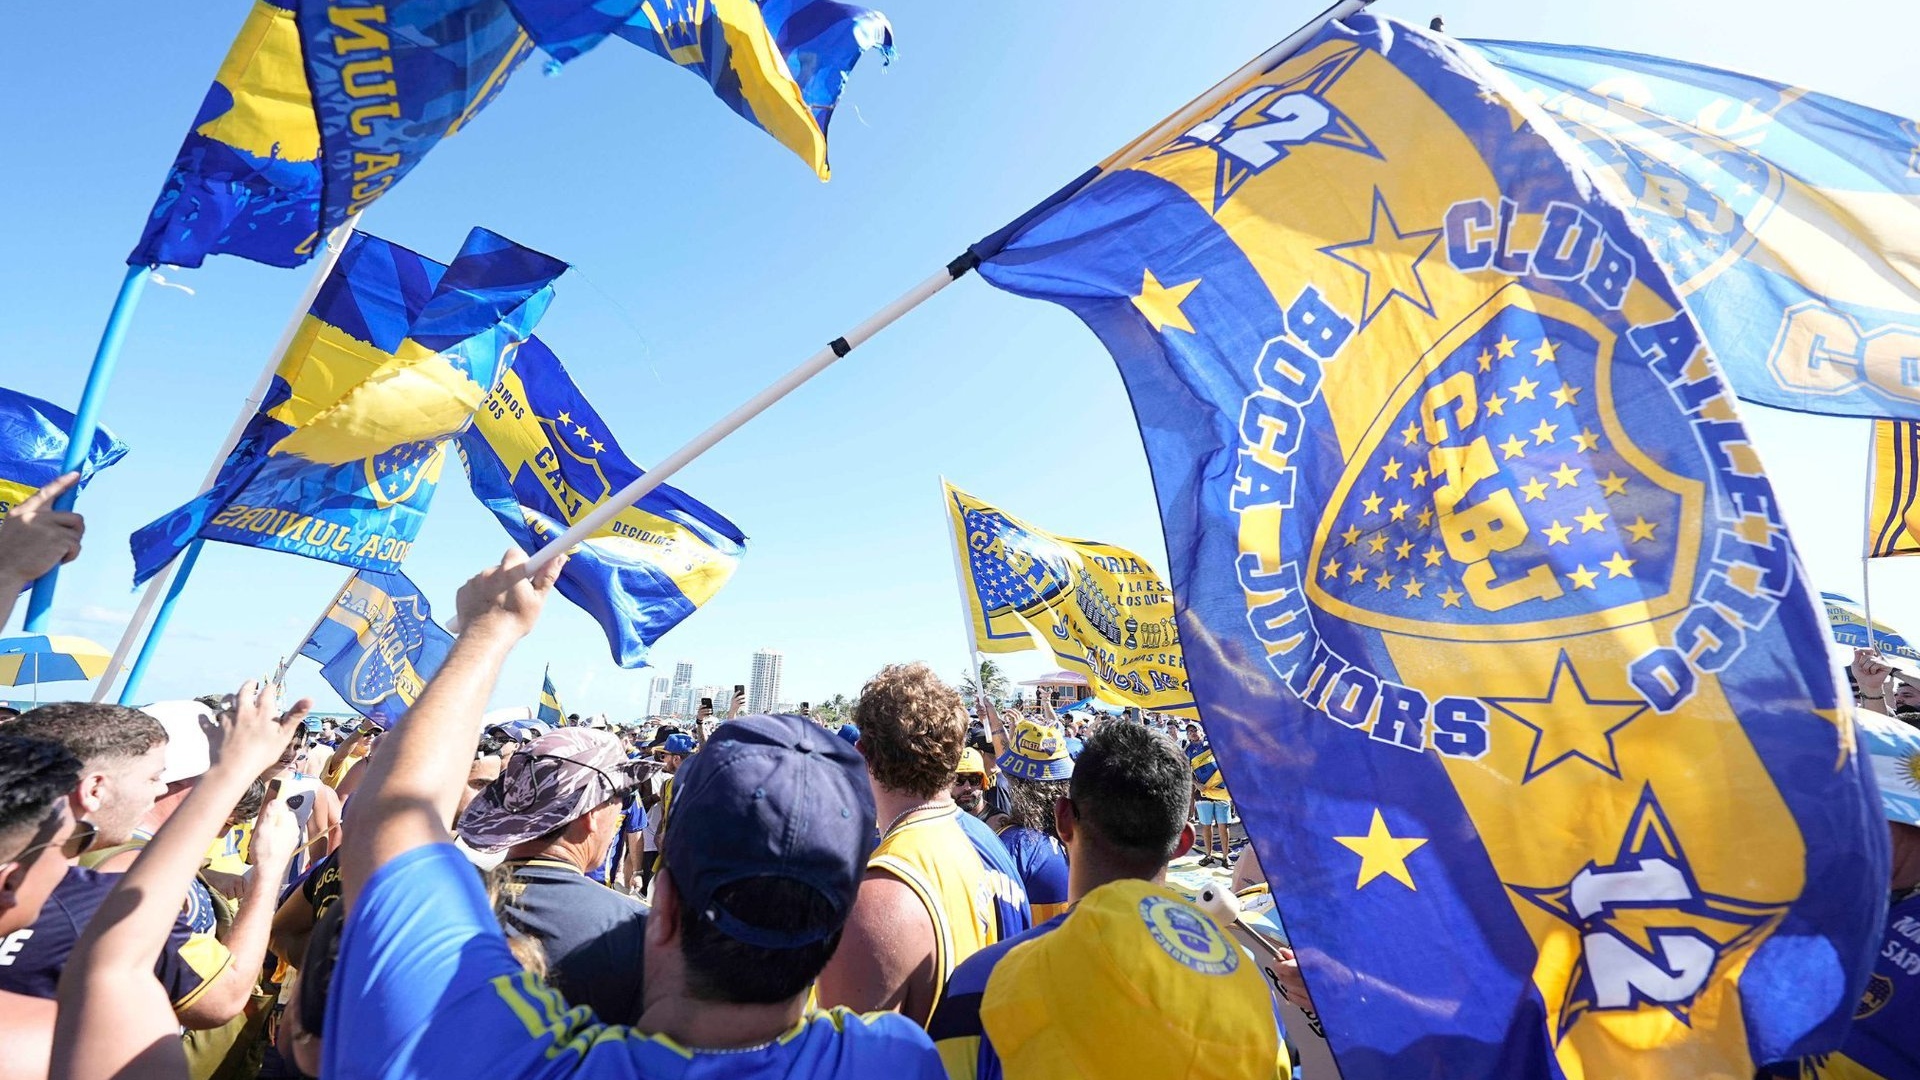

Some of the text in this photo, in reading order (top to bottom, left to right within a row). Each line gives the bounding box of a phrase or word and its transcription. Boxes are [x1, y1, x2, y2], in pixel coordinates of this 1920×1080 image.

[1184, 86, 1331, 169] 12
[1442, 196, 1636, 311] CLUB
[496, 381, 525, 420] OMOS
[1420, 371, 1565, 612] CABJ
[1230, 285, 1491, 760] BOCA JUNIORS
[970, 530, 1055, 594] CABJ
[1090, 556, 1145, 575] ORIA
[1146, 580, 1170, 592] ES
[1117, 595, 1142, 606] LOS
[1001, 755, 1055, 779] BOCA
[0, 928, 35, 966] E
[1571, 858, 1715, 1008] 12
